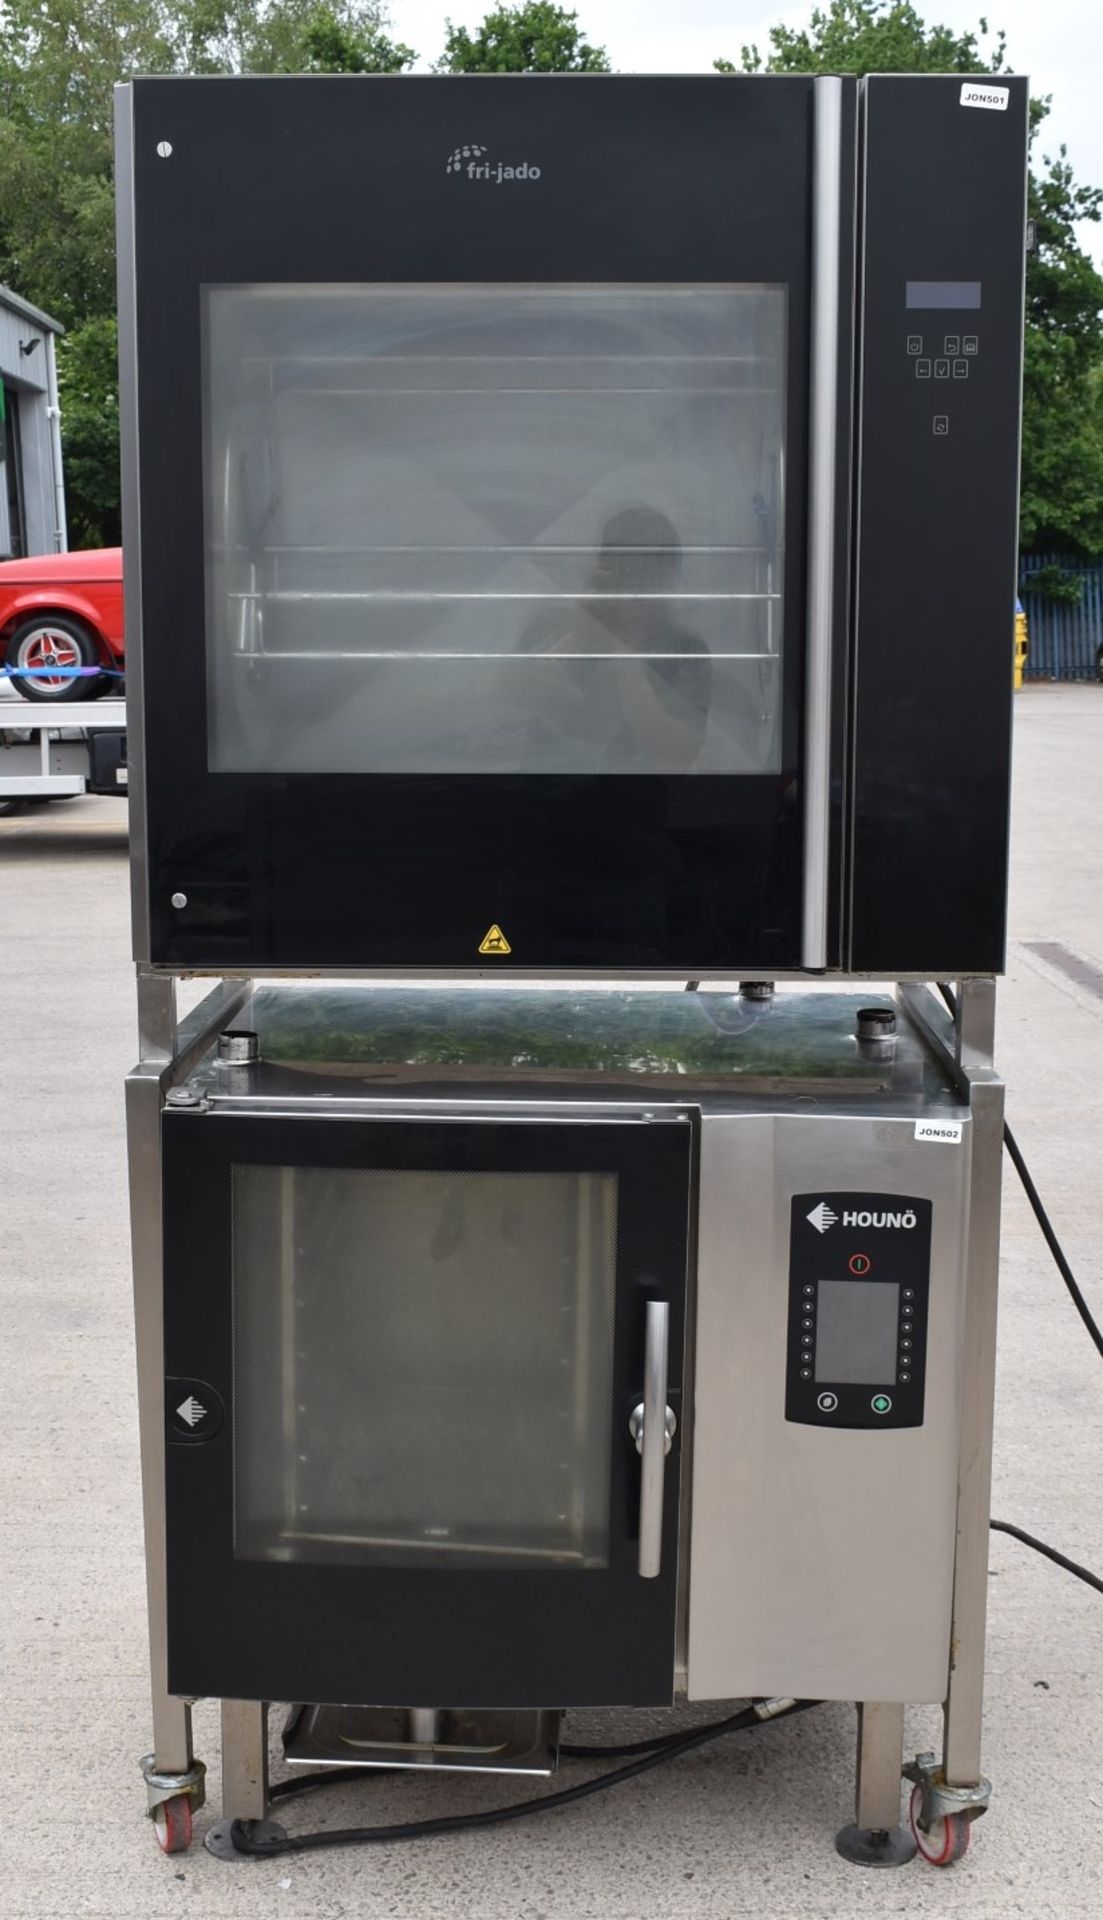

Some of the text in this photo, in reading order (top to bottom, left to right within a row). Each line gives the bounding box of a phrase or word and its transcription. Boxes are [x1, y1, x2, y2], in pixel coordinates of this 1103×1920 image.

[965, 92, 1005, 105] JON501
[466, 162, 541, 184] fri-jado
[919, 1128, 959, 1139] JON502
[842, 1209, 917, 1229] HOUNÖ
